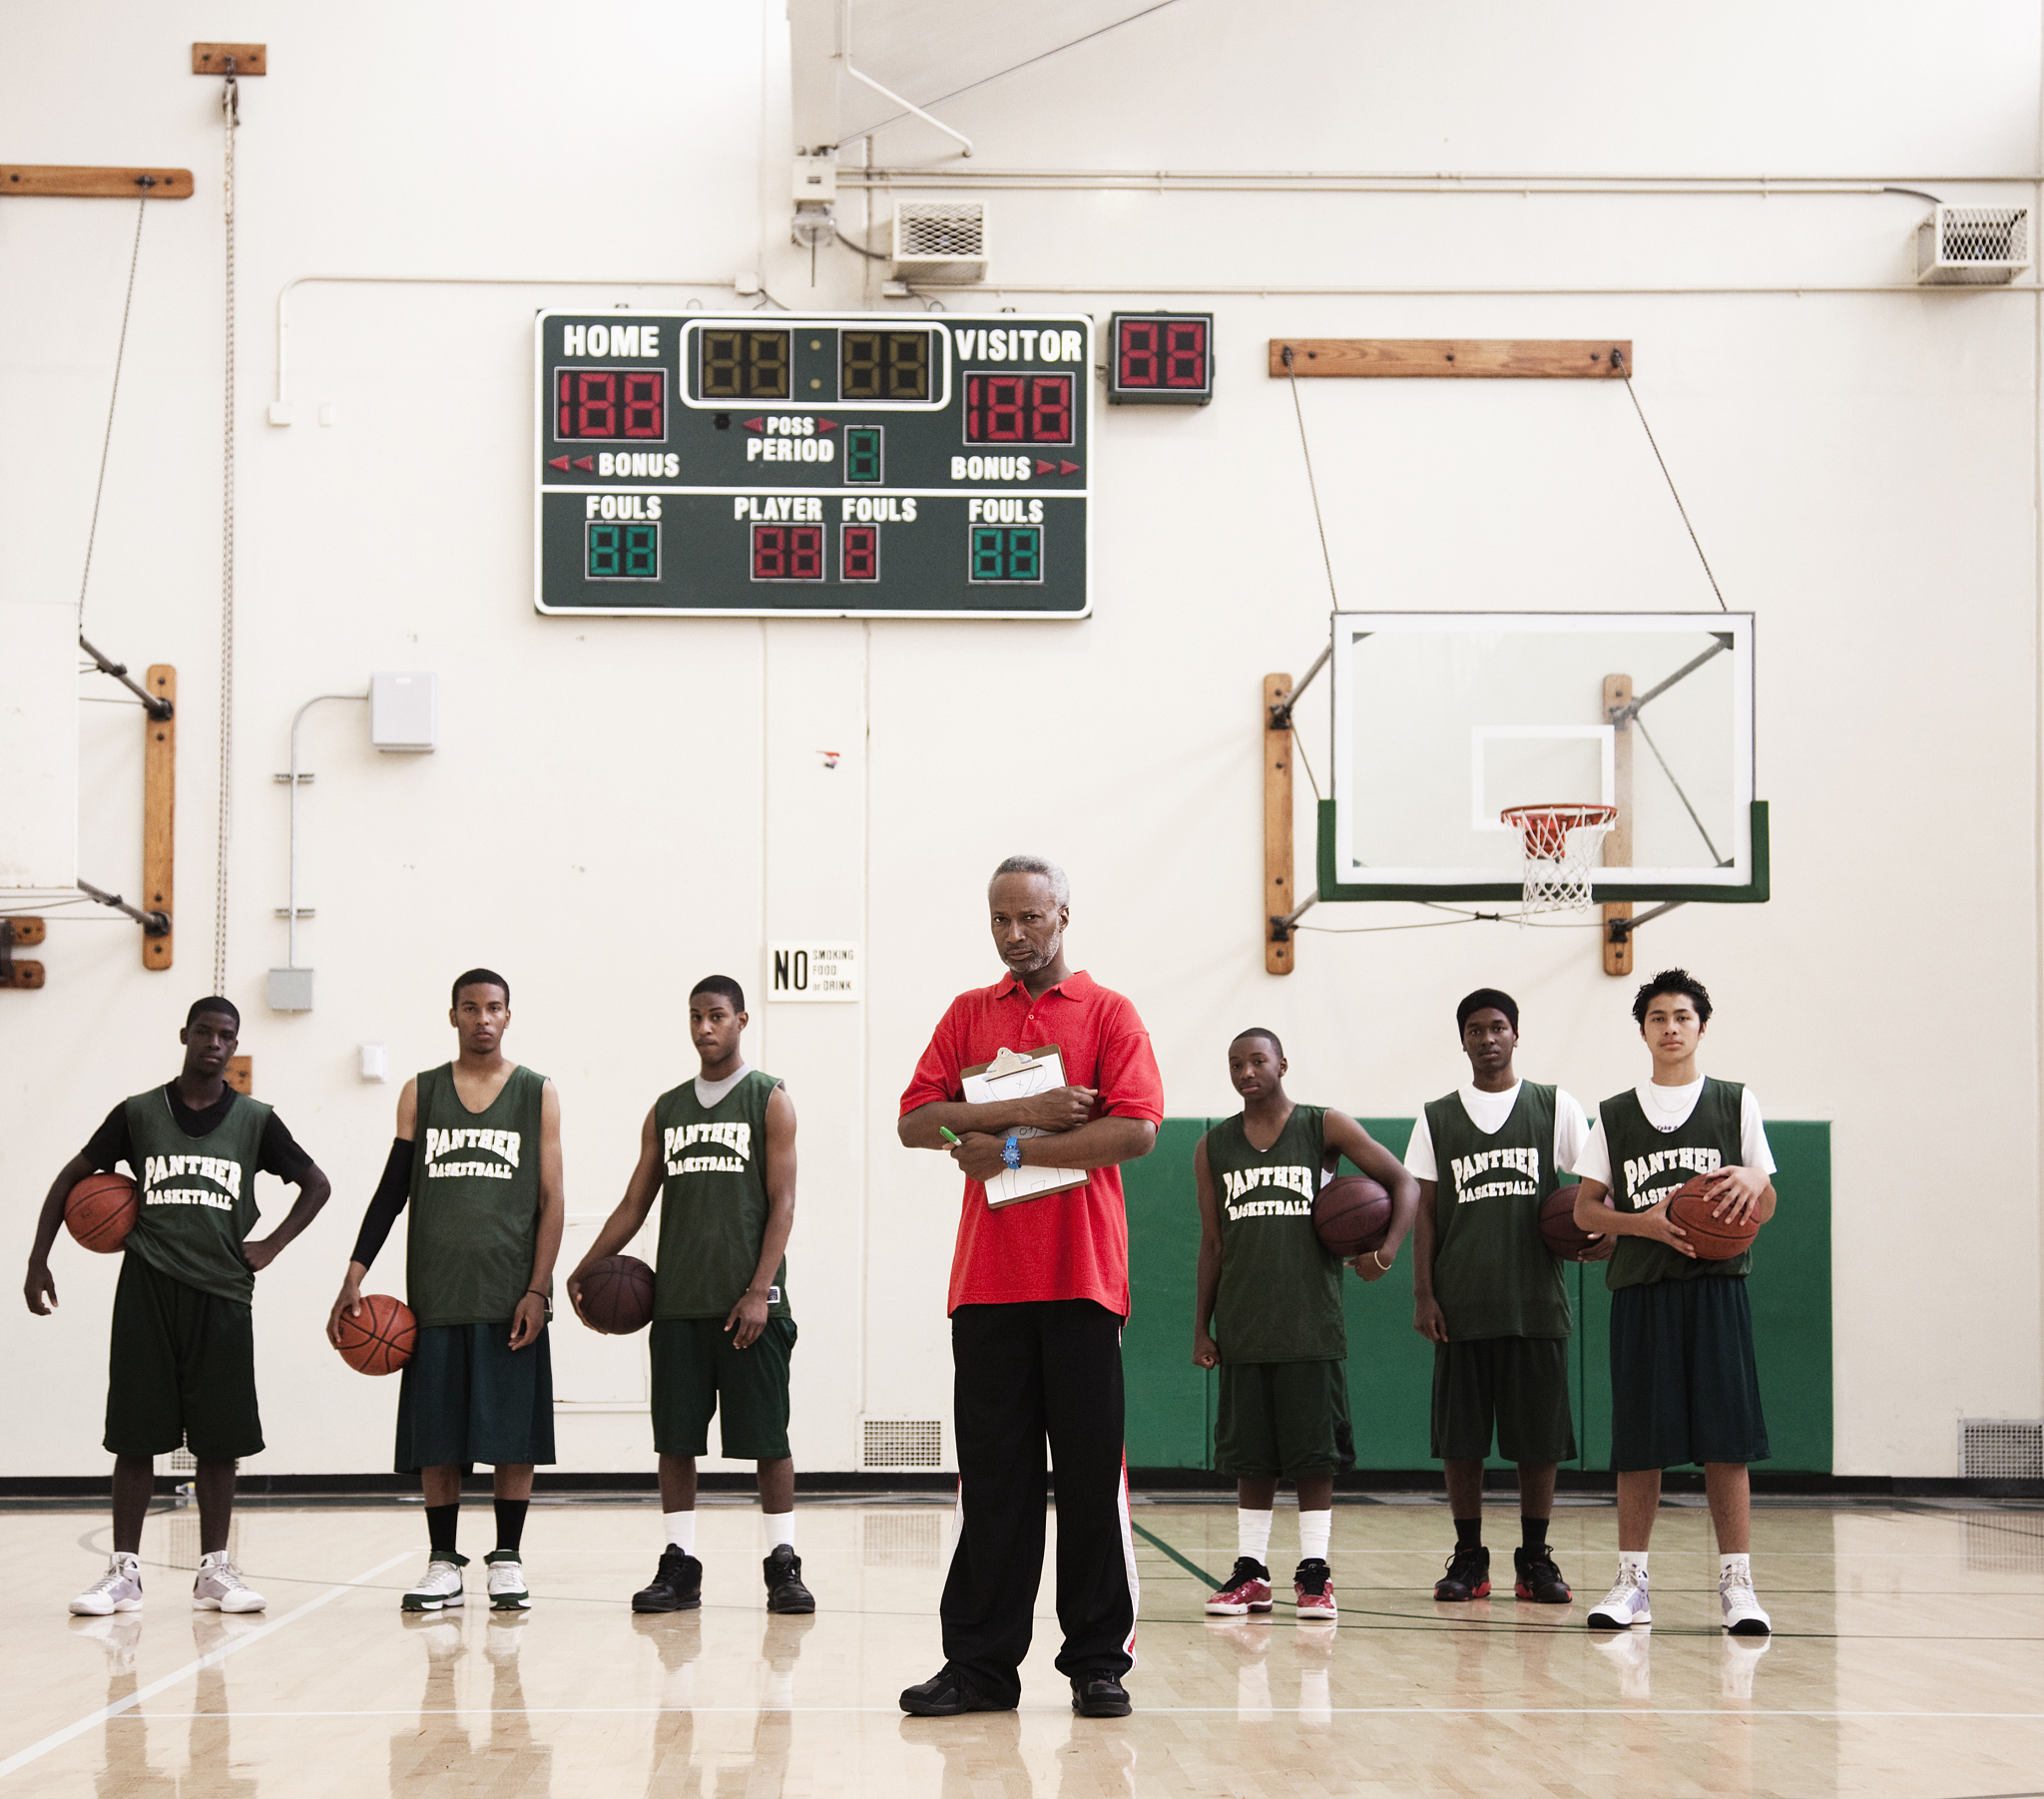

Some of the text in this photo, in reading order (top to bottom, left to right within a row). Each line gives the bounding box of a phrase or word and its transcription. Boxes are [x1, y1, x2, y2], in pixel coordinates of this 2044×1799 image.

[563, 324, 660, 357] HOME
[954, 328, 1082, 362] VISITOR
[766, 416, 815, 436] POSS
[747, 437, 835, 463] PERIOD
[599, 452, 681, 478] BONUS
[951, 456, 1032, 481] BONUS
[586, 495, 663, 520] FOULS
[734, 496, 917, 522] PLAYER FOULS
[968, 499, 1045, 523] FOULS
[812, 950, 853, 960] SMOKING
[774, 950, 808, 991] NO
[812, 965, 837, 976] FOOD
[823, 980, 851, 991] DRINK
[424, 1127, 521, 1168] PANTHER
[664, 1122, 752, 1164] PANTHER
[144, 1154, 243, 1200] PANTHER
[427, 1160, 513, 1179] BASKETBALL
[667, 1155, 745, 1176] BASKETBALL
[1450, 1146, 1540, 1194] PANTHER
[146, 1189, 234, 1211] BASKETBALL
[1223, 1165, 1314, 1210] PANTHER
[1458, 1180, 1537, 1204] BASKETBALL
[1228, 1199, 1310, 1222] BASKETBALL
